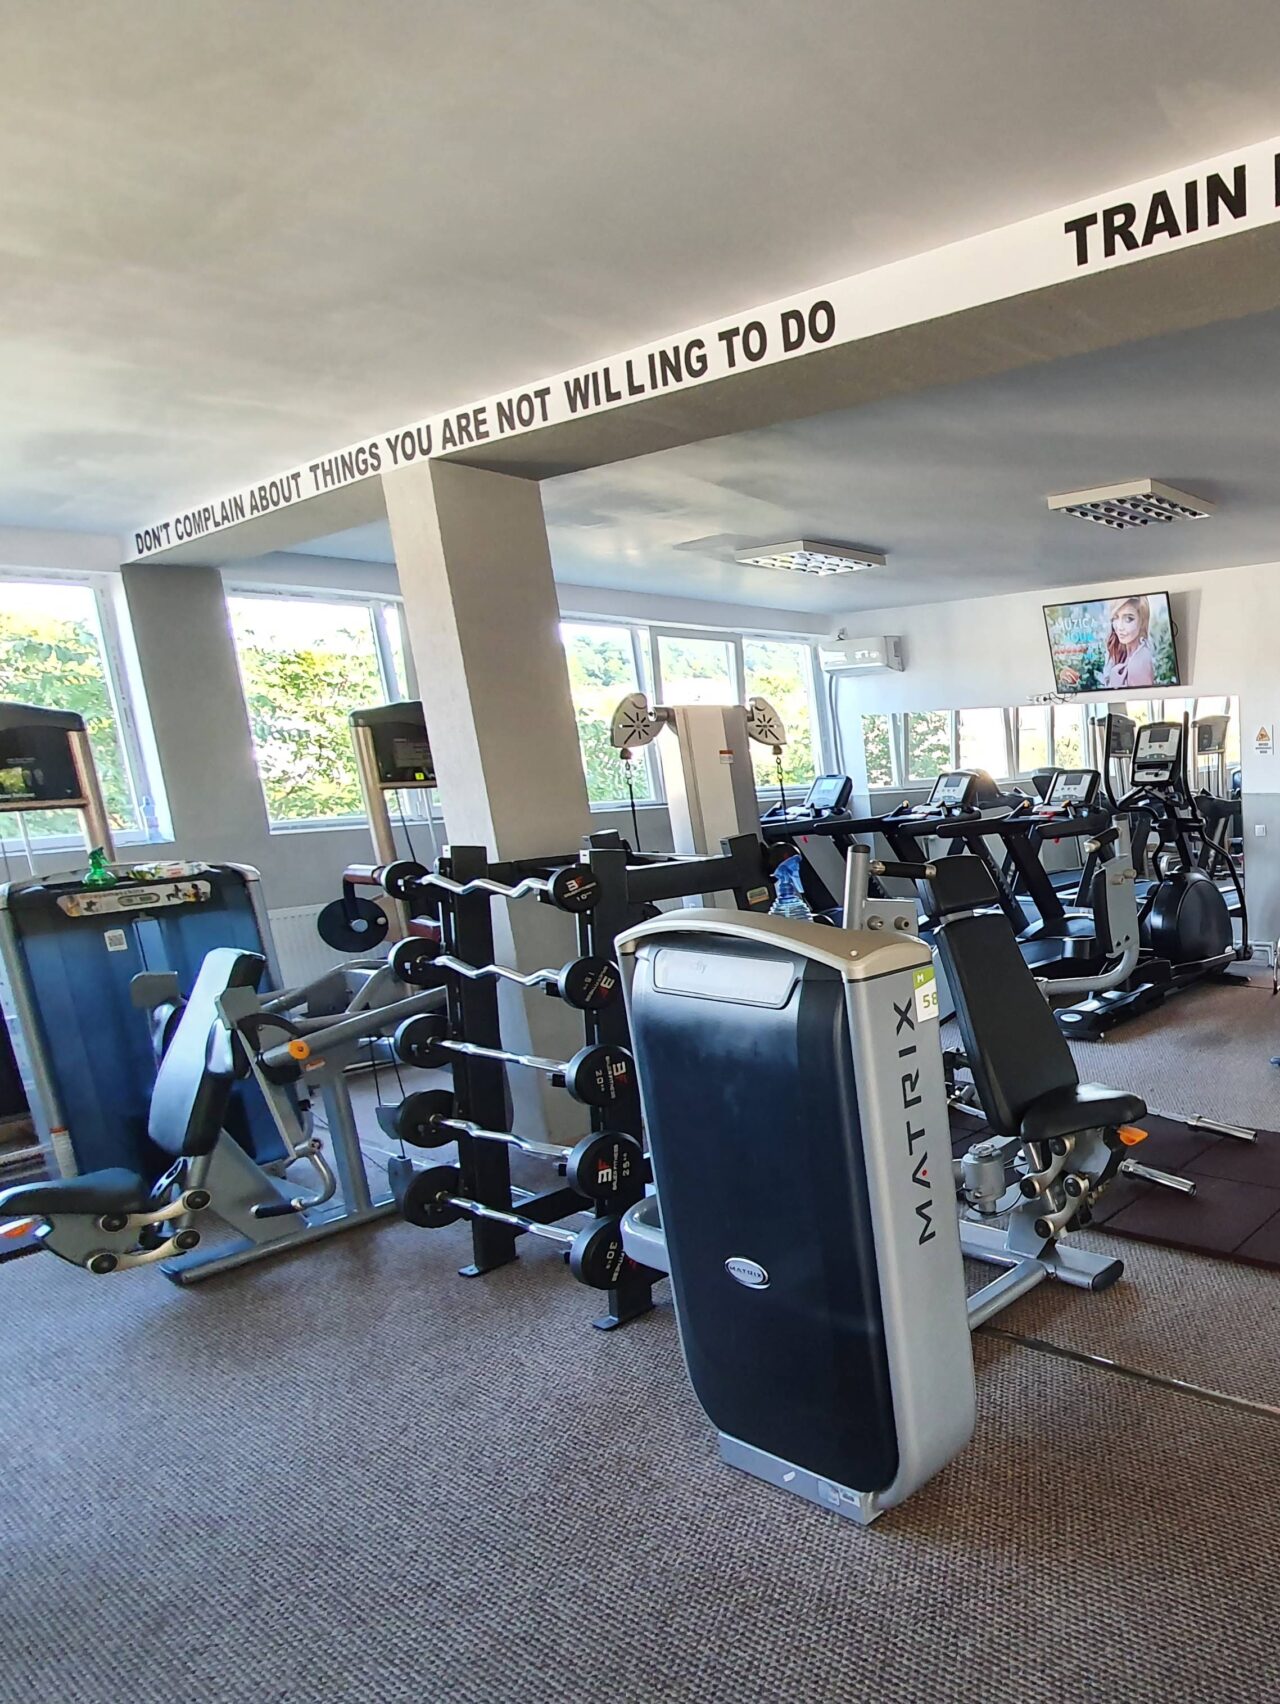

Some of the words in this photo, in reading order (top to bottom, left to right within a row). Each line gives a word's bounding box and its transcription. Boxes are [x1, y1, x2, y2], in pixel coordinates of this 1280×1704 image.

[1063, 164, 1249, 266] TRAIN
[135, 522, 171, 554] DON'T
[175, 494, 246, 541] COMPLAIN
[249, 472, 301, 516] ABOUT
[309, 442, 382, 491] THINGS
[385, 424, 433, 466] YOU
[441, 406, 490, 451] ARE
[496, 387, 551, 434] NOT
[563, 338, 709, 414] WILLING
[718, 320, 768, 369] TO
[780, 300, 836, 353] DO
[916, 973, 924, 983] M
[922, 991, 938, 1009] 58
[893, 997, 936, 1246] MATRIX
